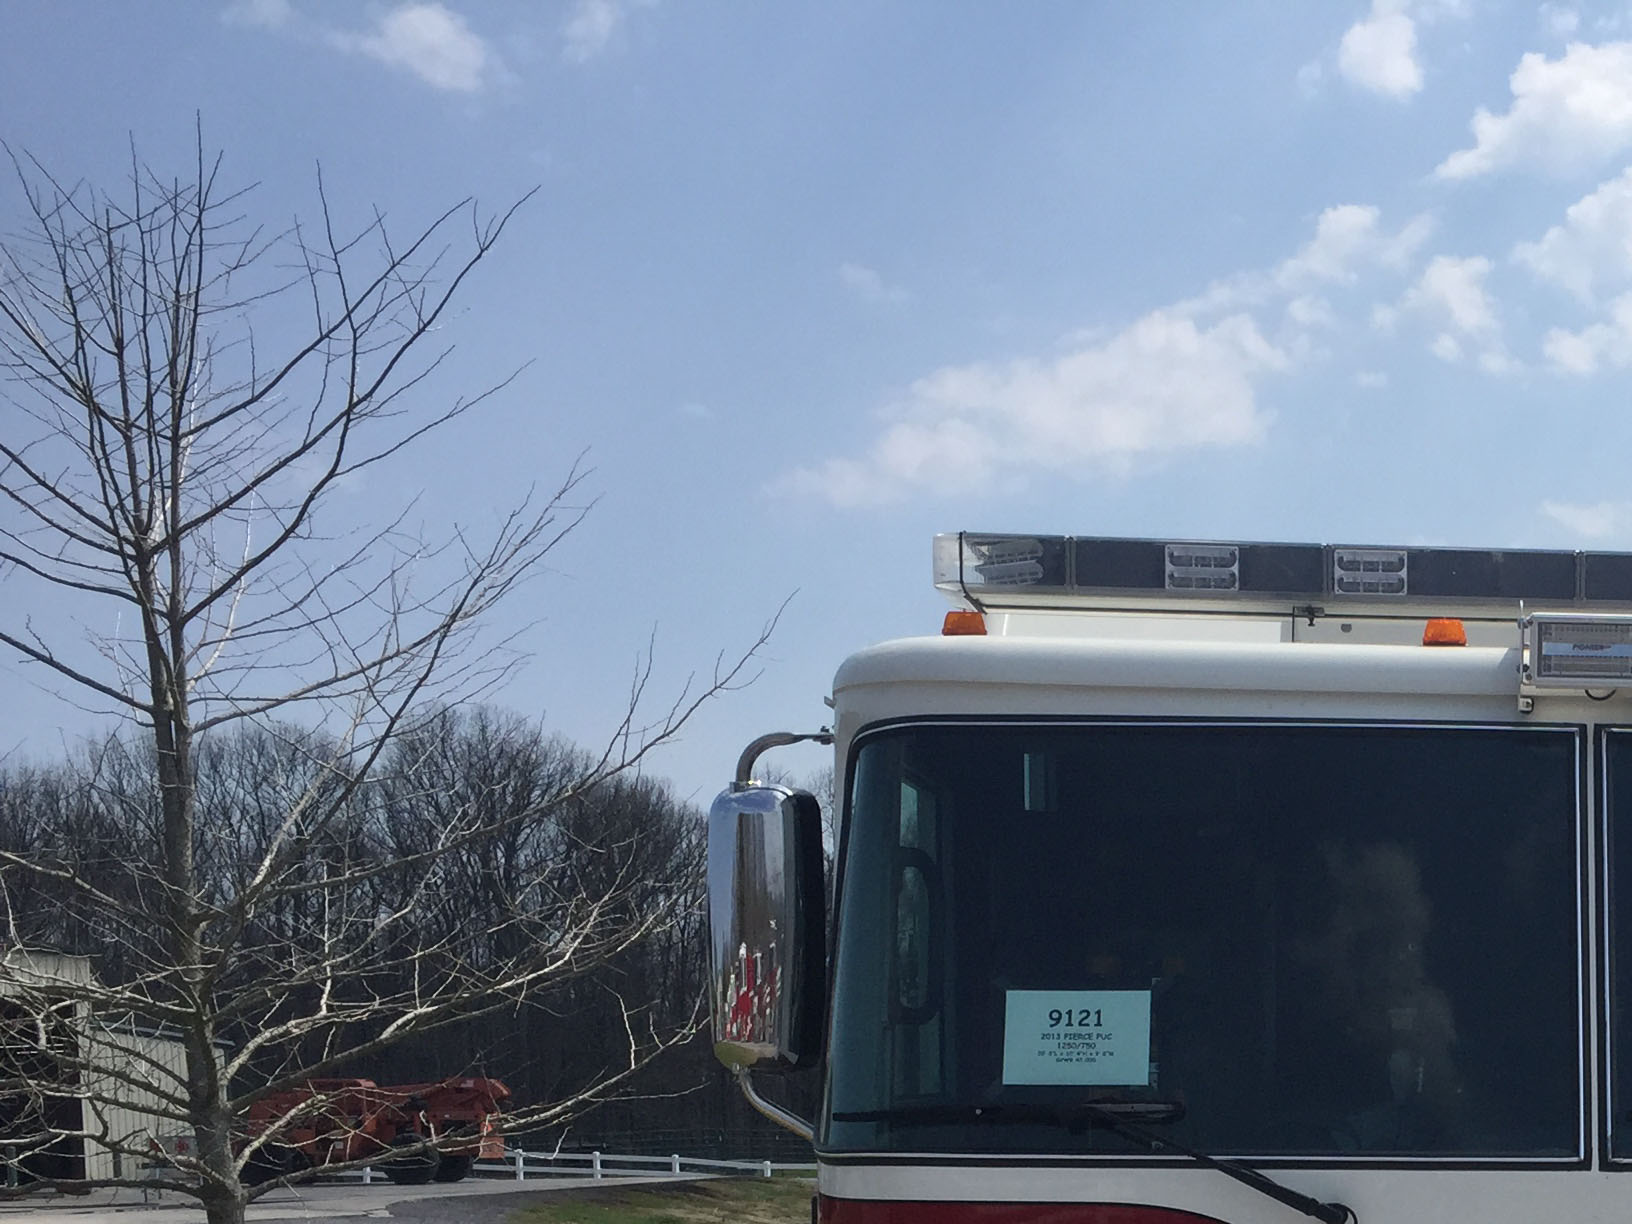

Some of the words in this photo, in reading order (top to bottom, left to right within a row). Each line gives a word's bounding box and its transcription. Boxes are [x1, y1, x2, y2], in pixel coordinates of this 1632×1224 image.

[1048, 1008, 1103, 1028] 9121
[1040, 1032, 1061, 1041] 2013
[1063, 1032, 1094, 1041] PIERCE
